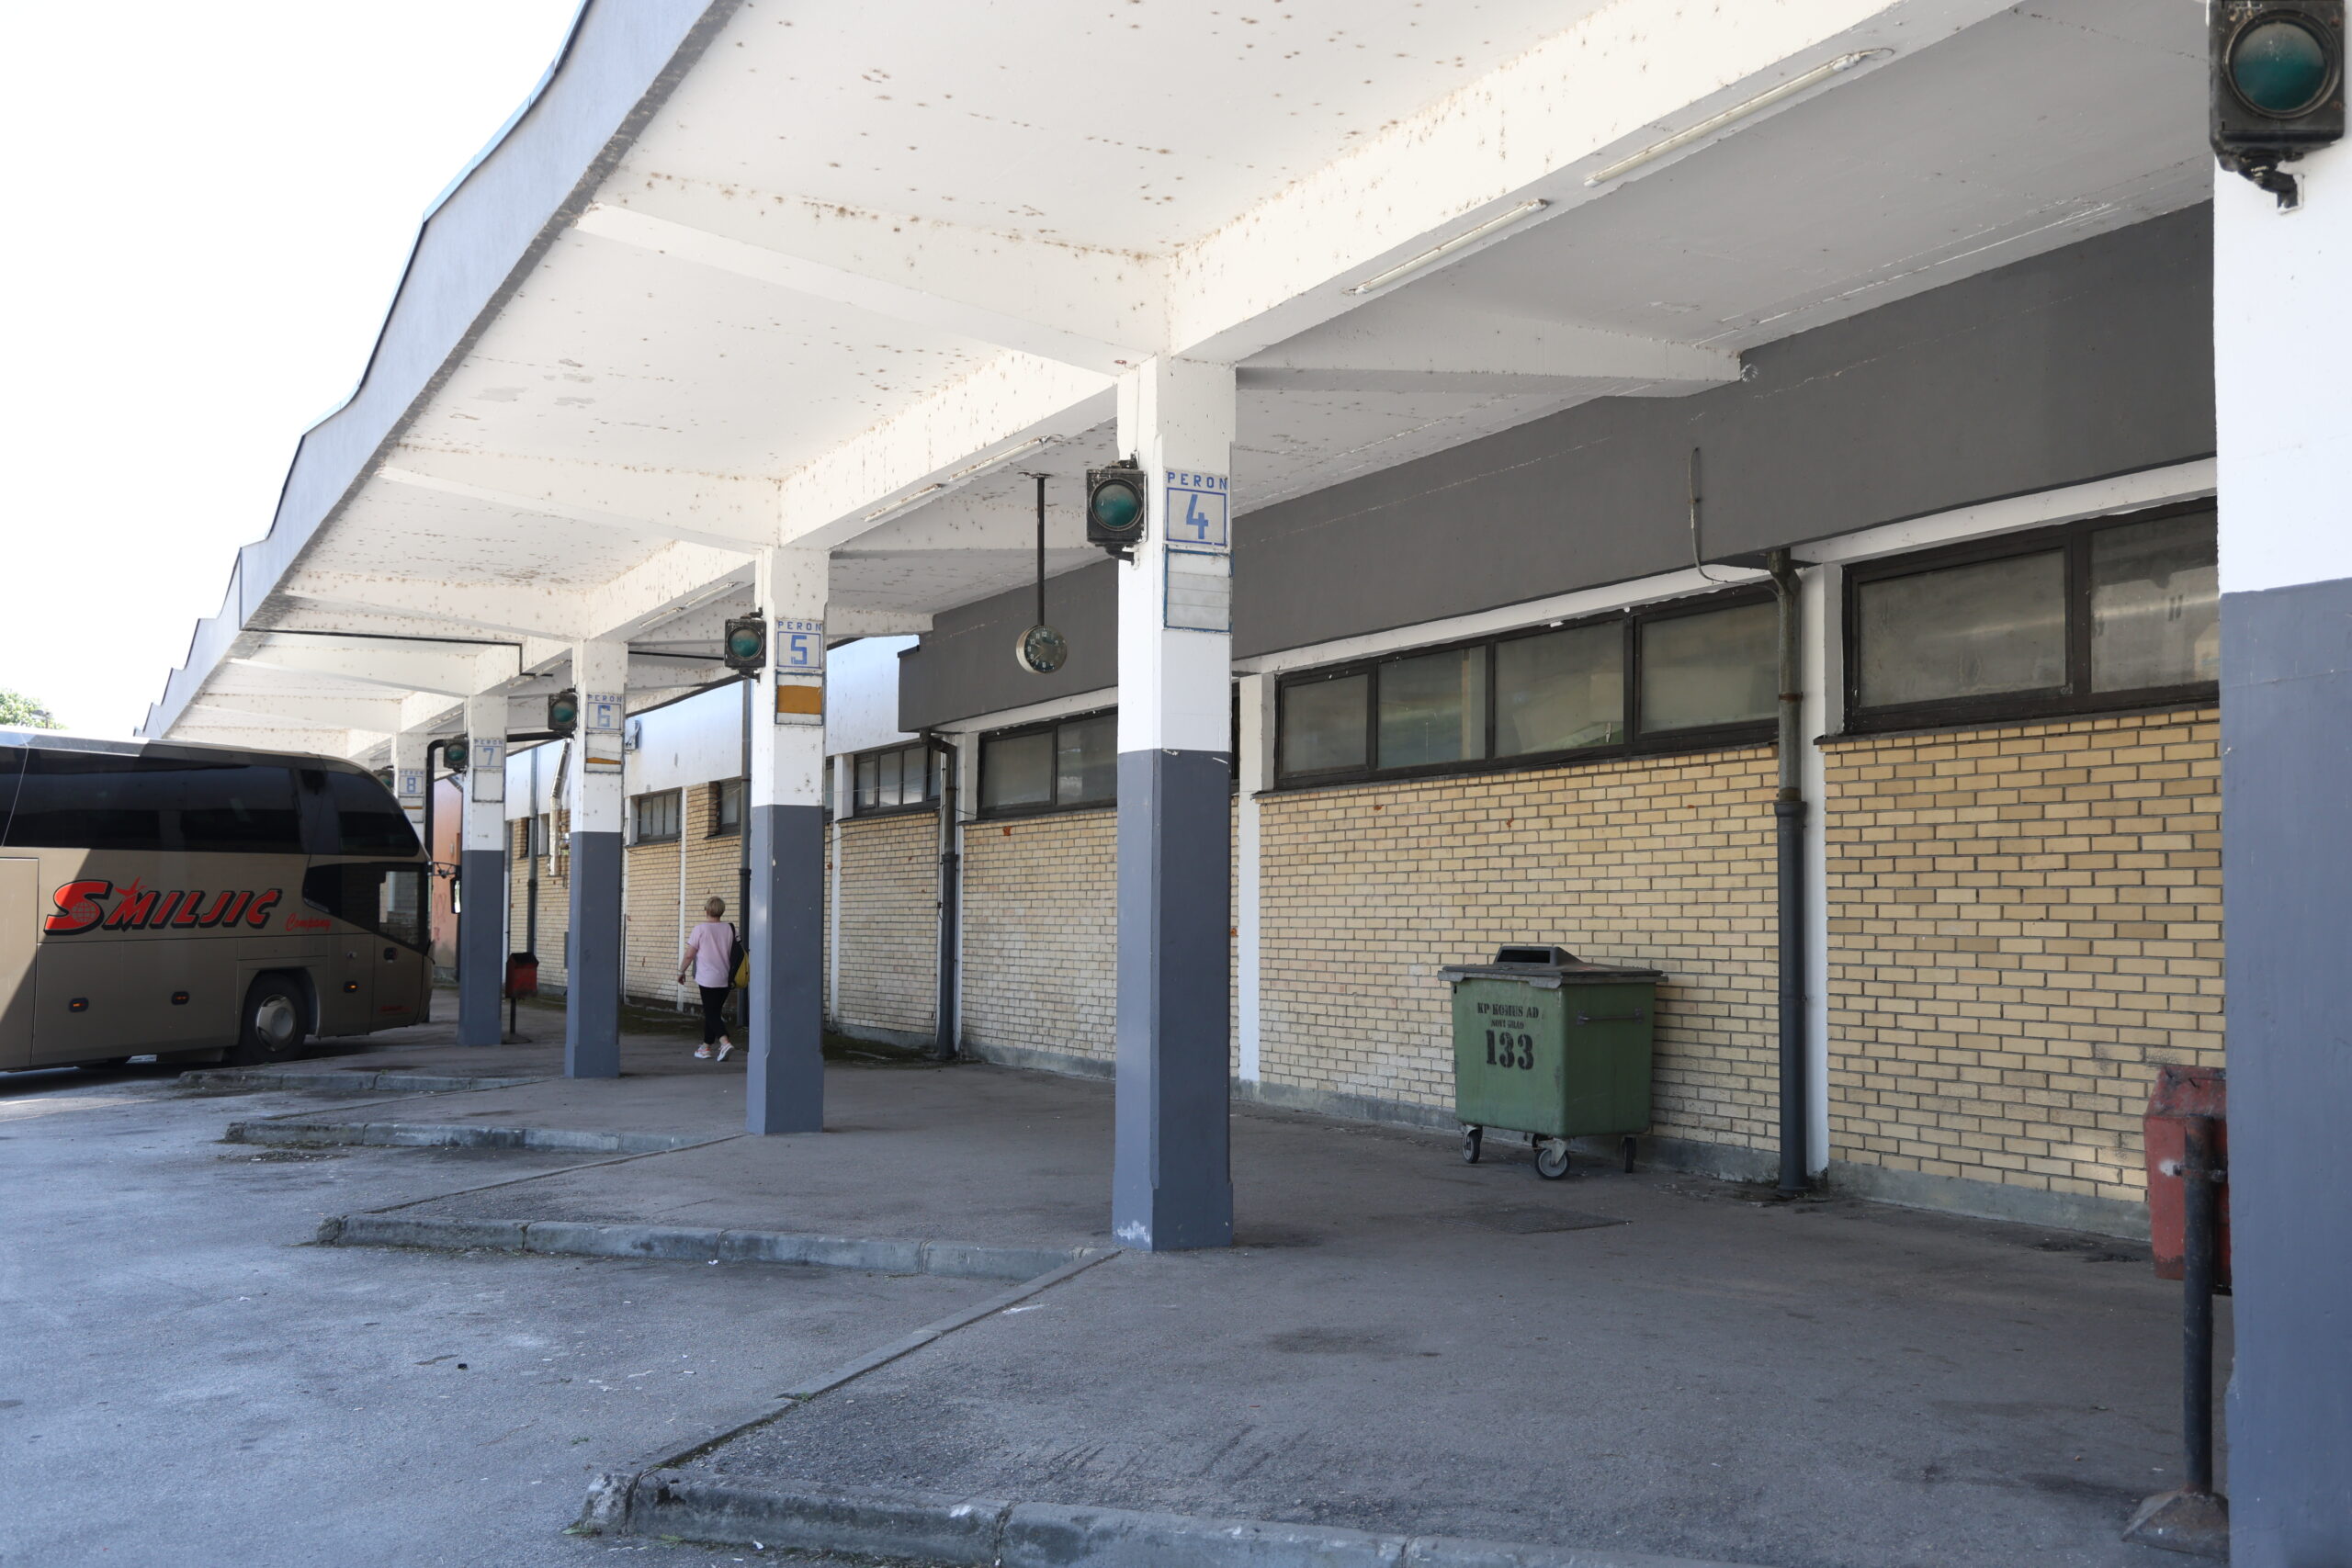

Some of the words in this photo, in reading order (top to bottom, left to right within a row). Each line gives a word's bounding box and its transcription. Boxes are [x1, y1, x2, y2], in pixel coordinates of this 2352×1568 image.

[1167, 471, 1227, 491] PERON
[1185, 493, 1209, 540] 4
[777, 620, 822, 632] PERON
[791, 635, 808, 665] 5
[587, 694, 623, 703] PERON
[597, 705, 611, 728] 6
[483, 747, 494, 766] 7
[406, 777, 416, 793] 8
[1477, 1002, 1489, 1014] KP
[1526, 1007, 1539, 1019] AD
[1486, 1030, 1534, 1070] 133
